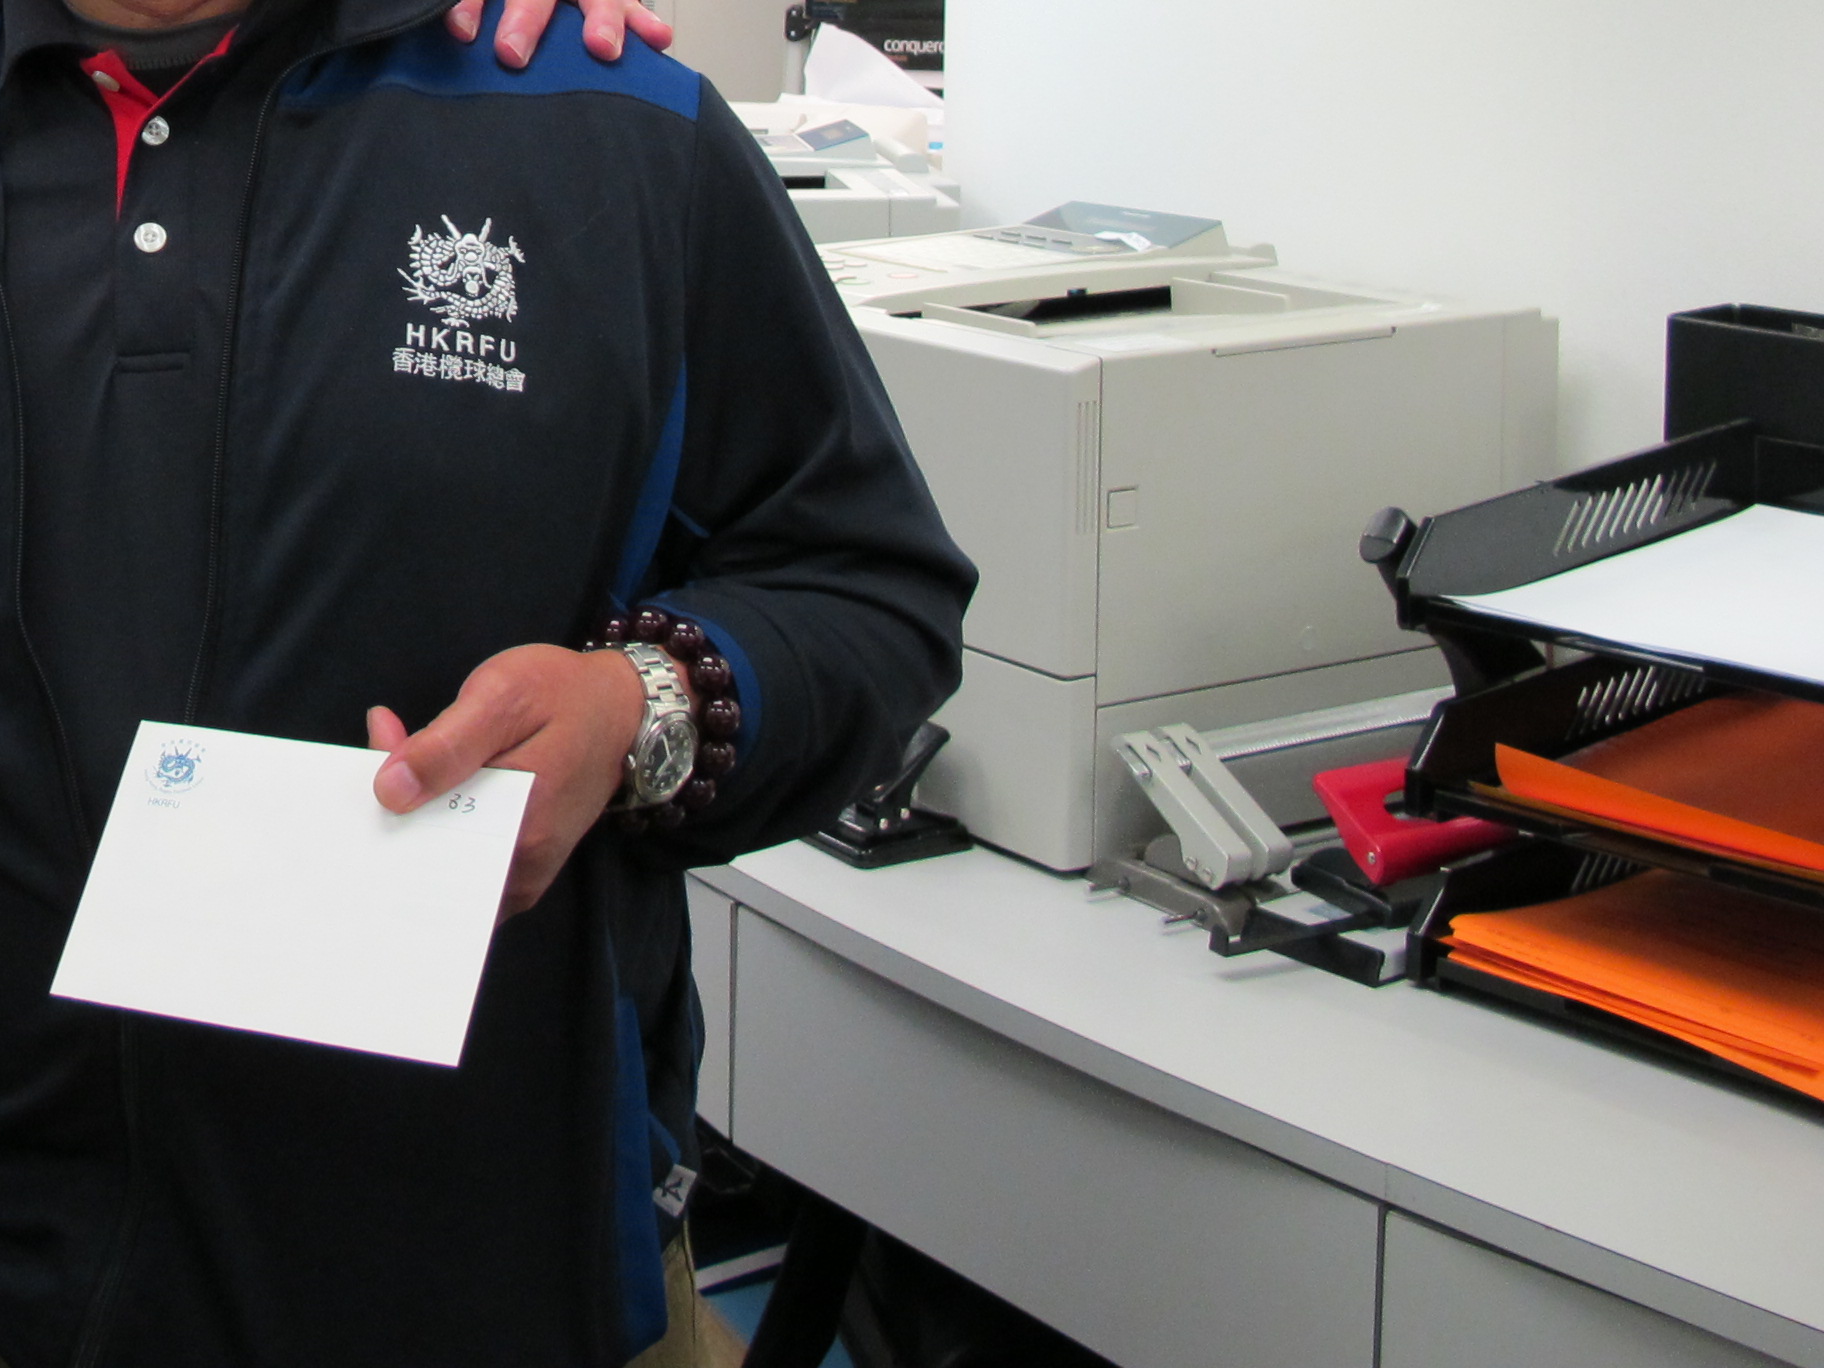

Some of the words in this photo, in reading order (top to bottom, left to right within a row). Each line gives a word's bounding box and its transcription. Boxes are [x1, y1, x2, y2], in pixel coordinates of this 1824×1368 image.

[406, 322, 517, 363] HKRFU
[392, 346, 527, 393] 香港欖球總會
[147, 797, 181, 809] HKRFU
